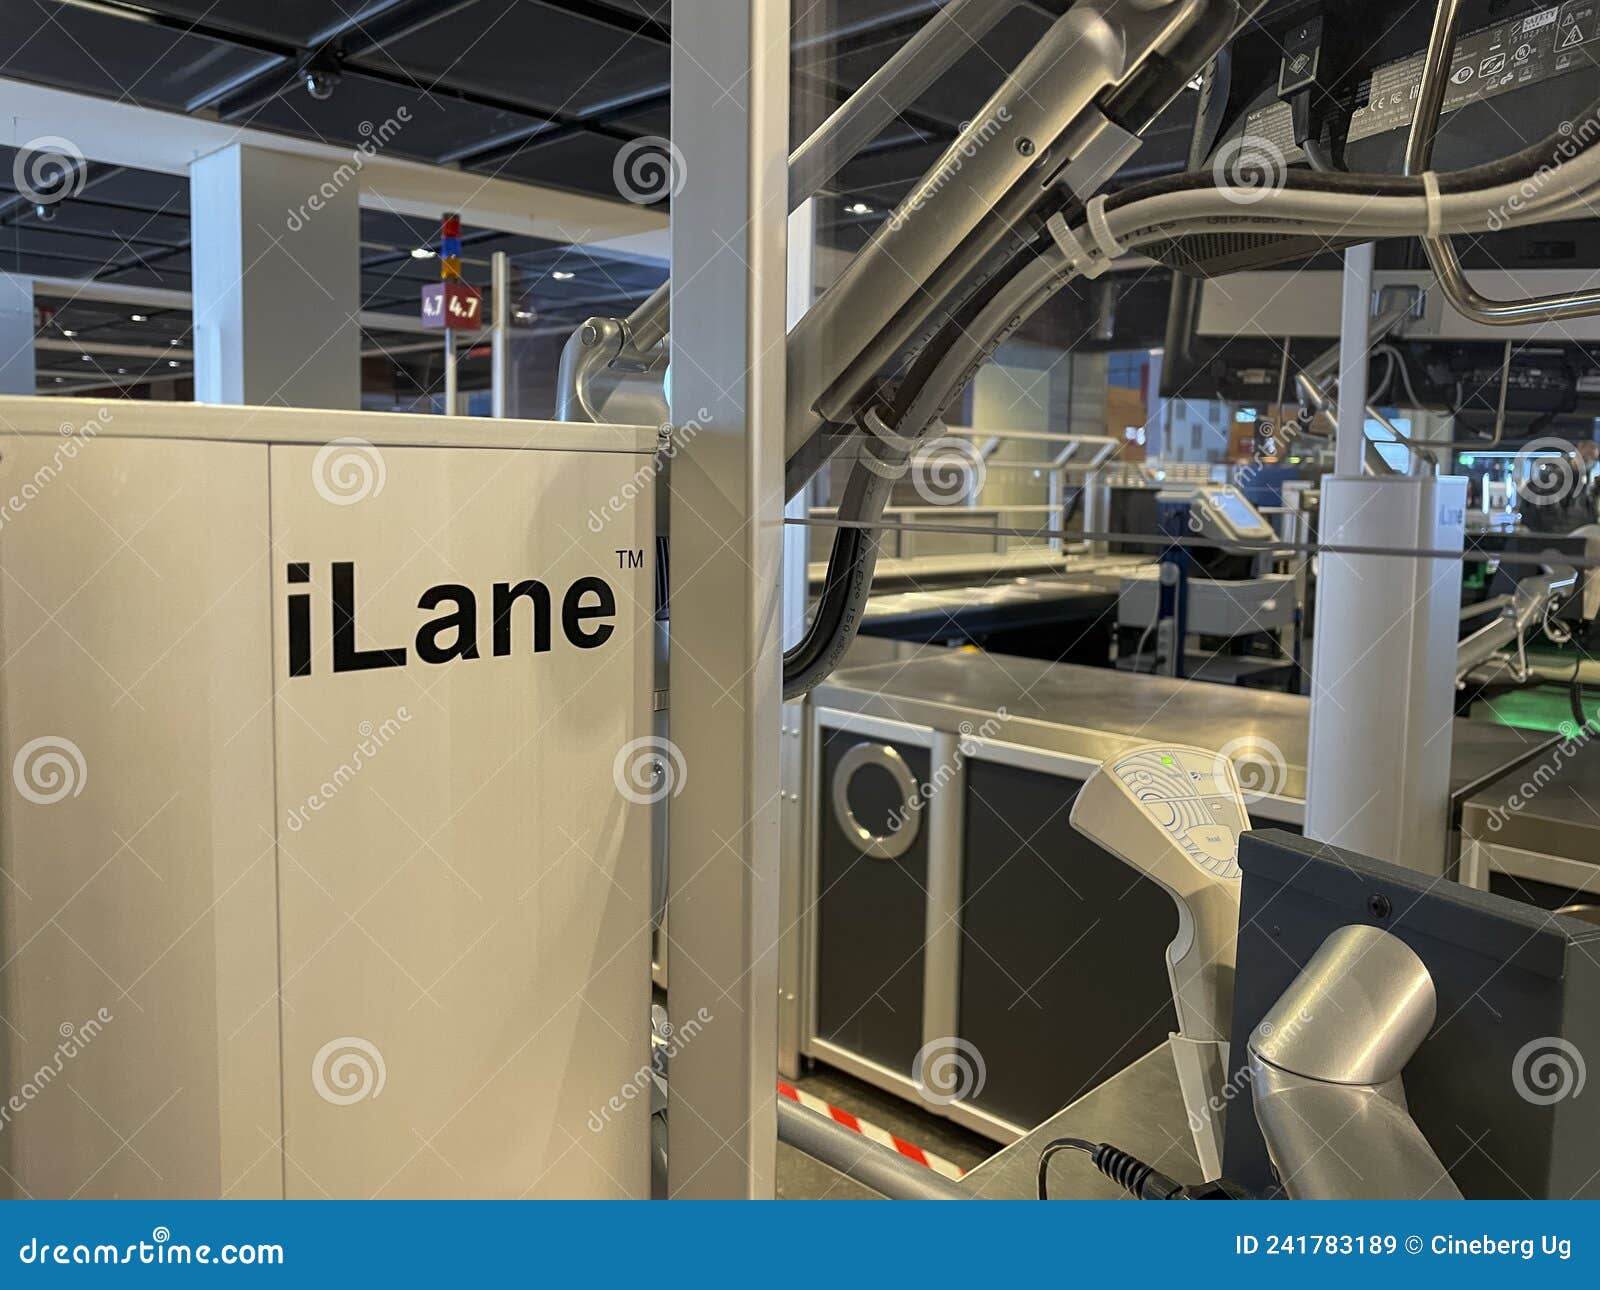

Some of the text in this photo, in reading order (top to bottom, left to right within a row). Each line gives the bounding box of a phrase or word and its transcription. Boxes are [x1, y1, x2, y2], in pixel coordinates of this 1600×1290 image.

[423, 295, 443, 316] 4.7
[449, 295, 478, 318] 4.7
[287, 561, 616, 677] iLane
